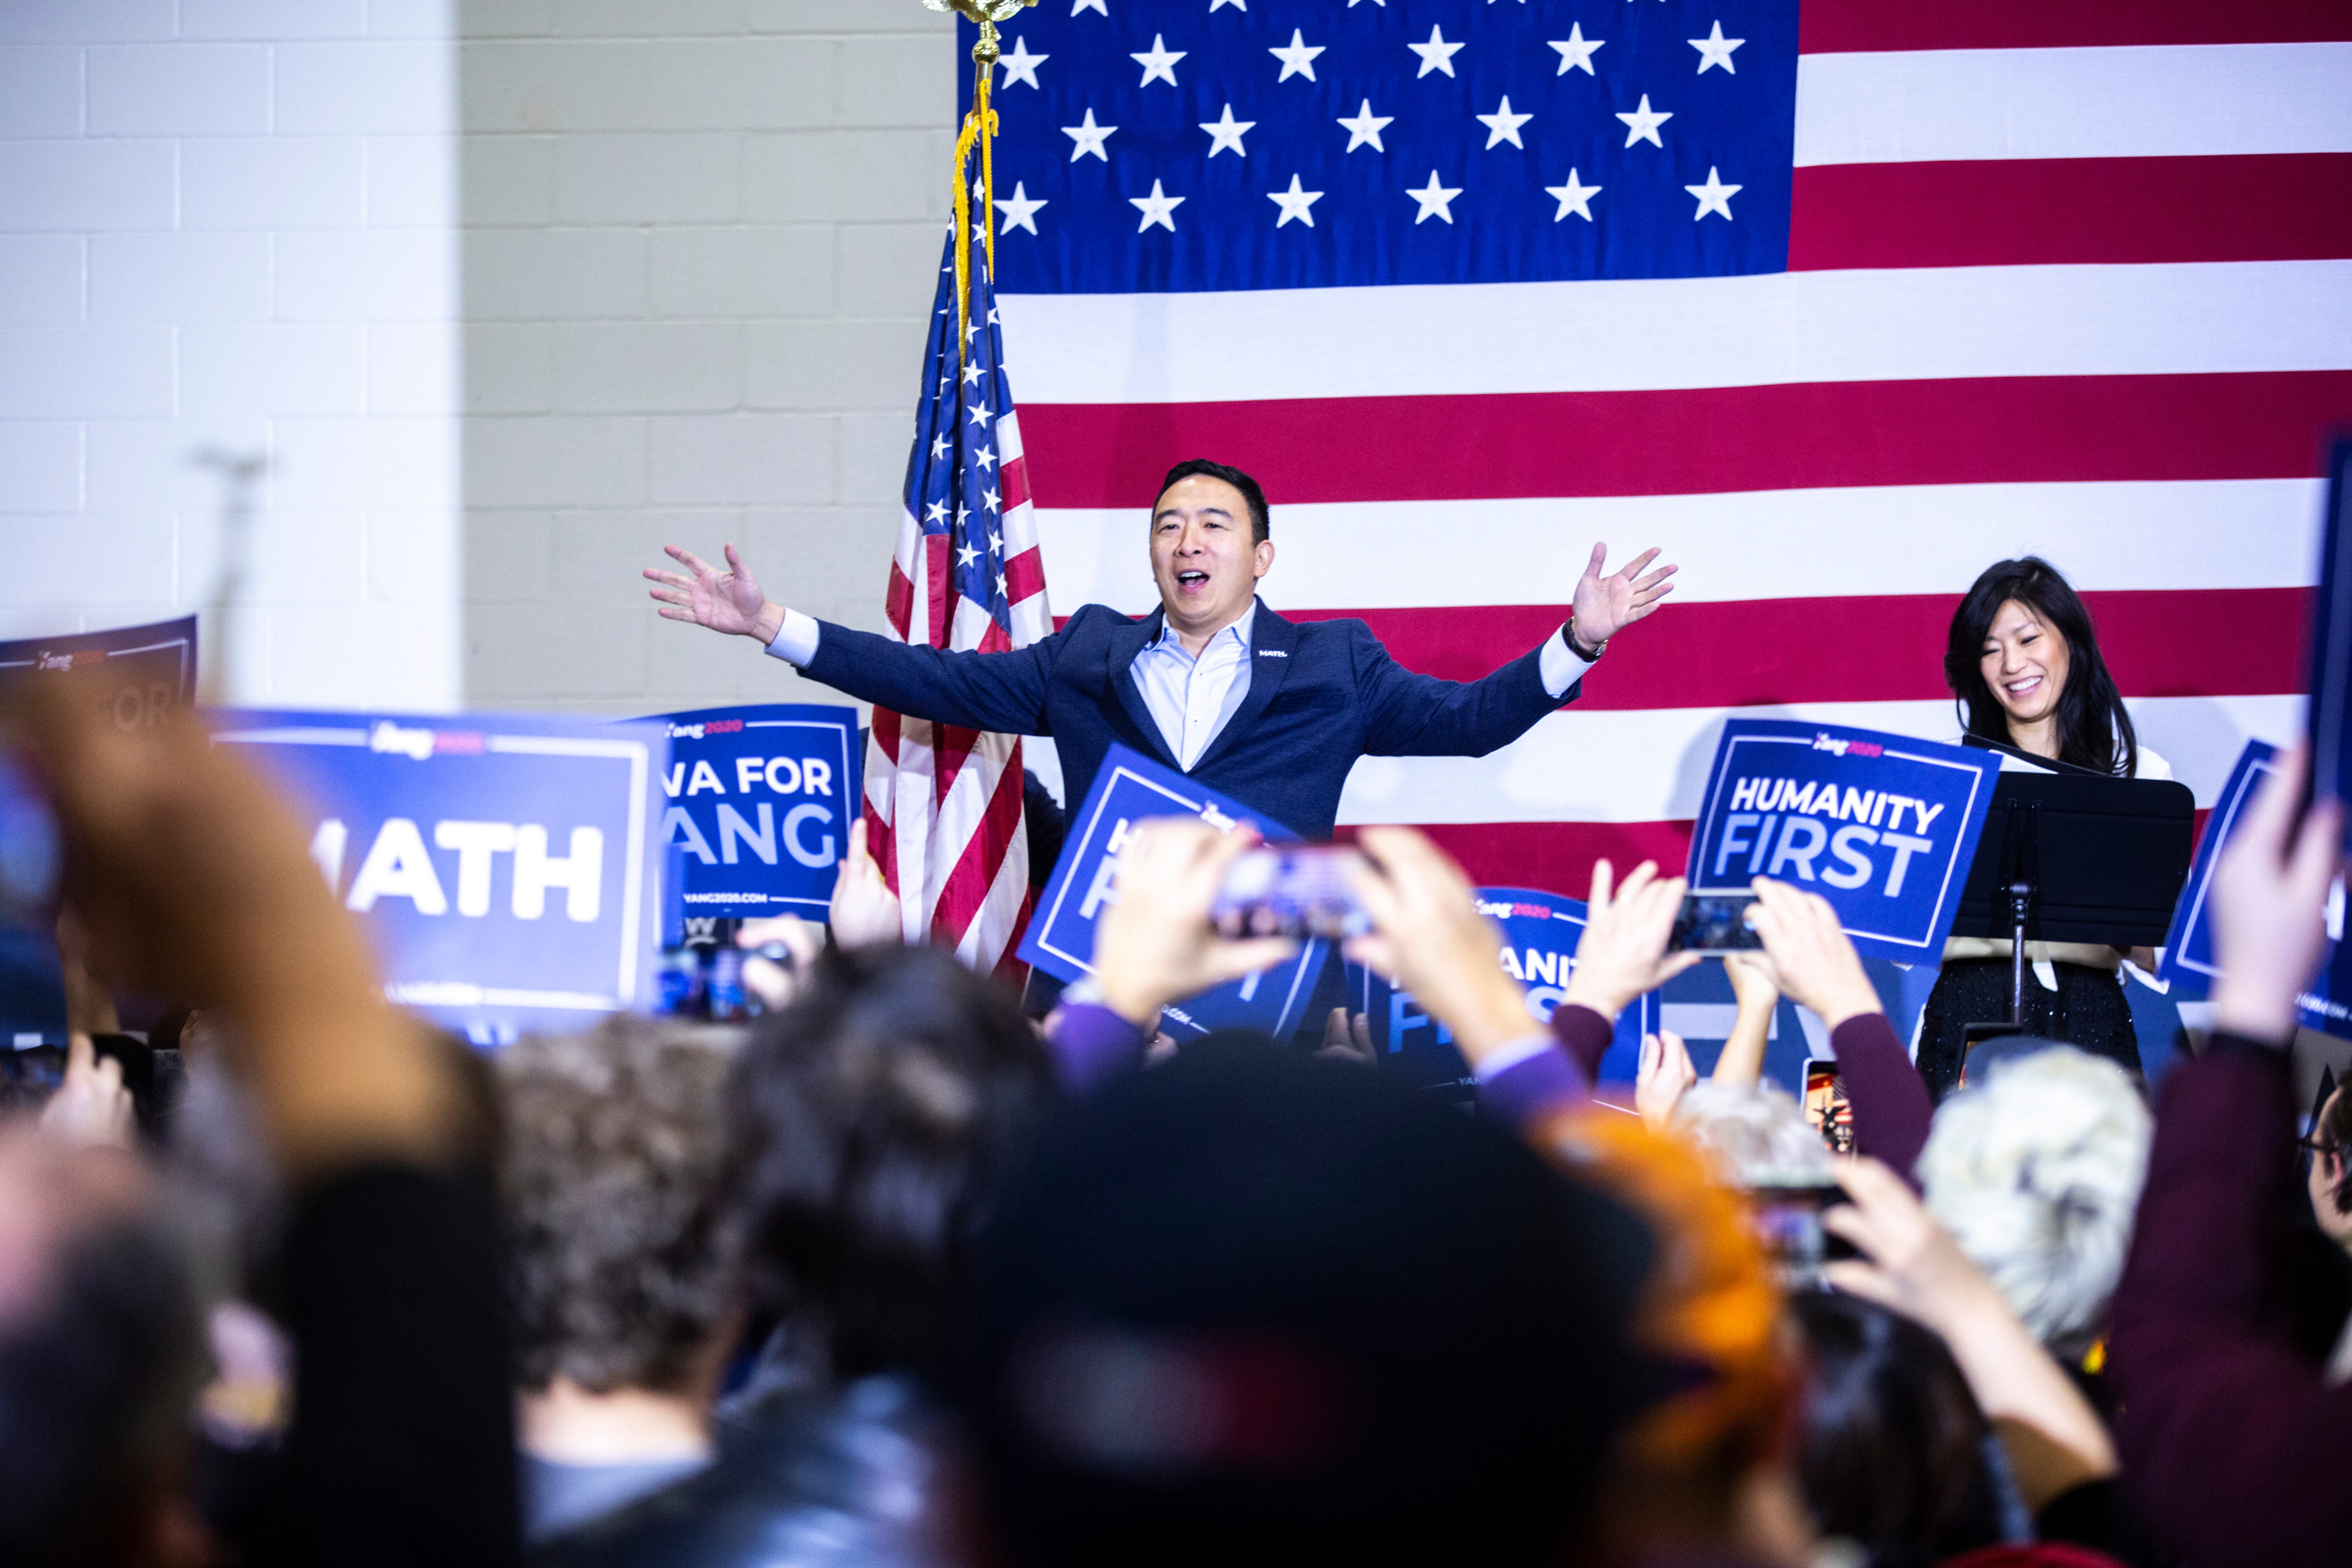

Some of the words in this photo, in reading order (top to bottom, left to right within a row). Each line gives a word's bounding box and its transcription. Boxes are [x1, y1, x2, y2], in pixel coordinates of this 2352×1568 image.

[735, 757, 833, 796] FOR
[1730, 777, 1945, 835] HUMANITY
[662, 802, 836, 869] ANG
[1713, 813, 1933, 898] FIRST
